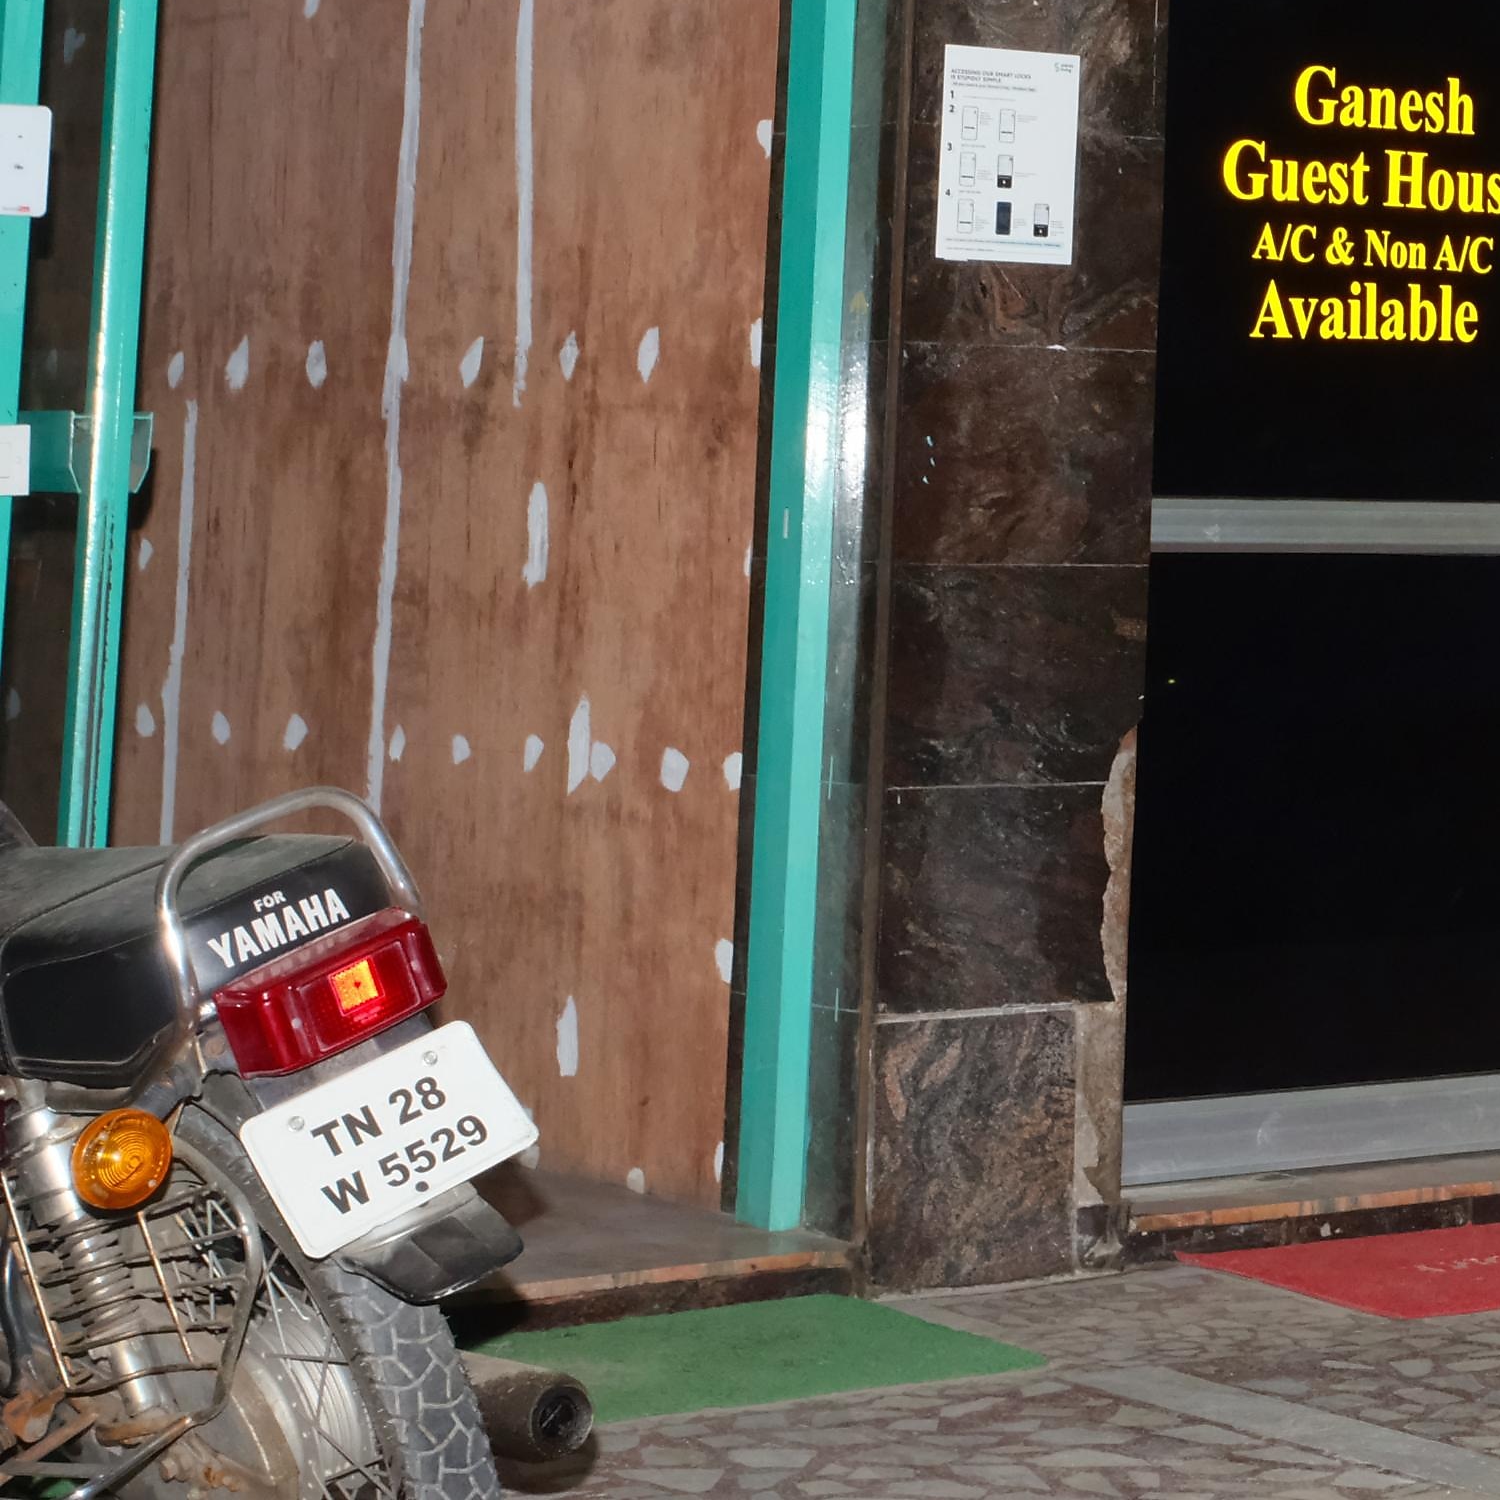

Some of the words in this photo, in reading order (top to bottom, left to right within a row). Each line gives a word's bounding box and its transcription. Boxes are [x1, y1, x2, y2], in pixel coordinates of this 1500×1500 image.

[1294, 64, 1476, 136] Ganesh
[1222, 139, 1371, 206] Guest
[1251, 221, 1318, 263] A/C
[1324, 226, 1355, 266] &
[1363, 228, 1427, 270] Non
[1432, 234, 1495, 275] A/C
[1249, 278, 1480, 344] Available
[207, 887, 351, 969] YAMAHA
[253, 889, 286, 913] FOR
[311, 1104, 383, 1158] TN
[388, 1076, 447, 1125] 28
[320, 1170, 371, 1216] W
[377, 1114, 488, 1188] 5529
